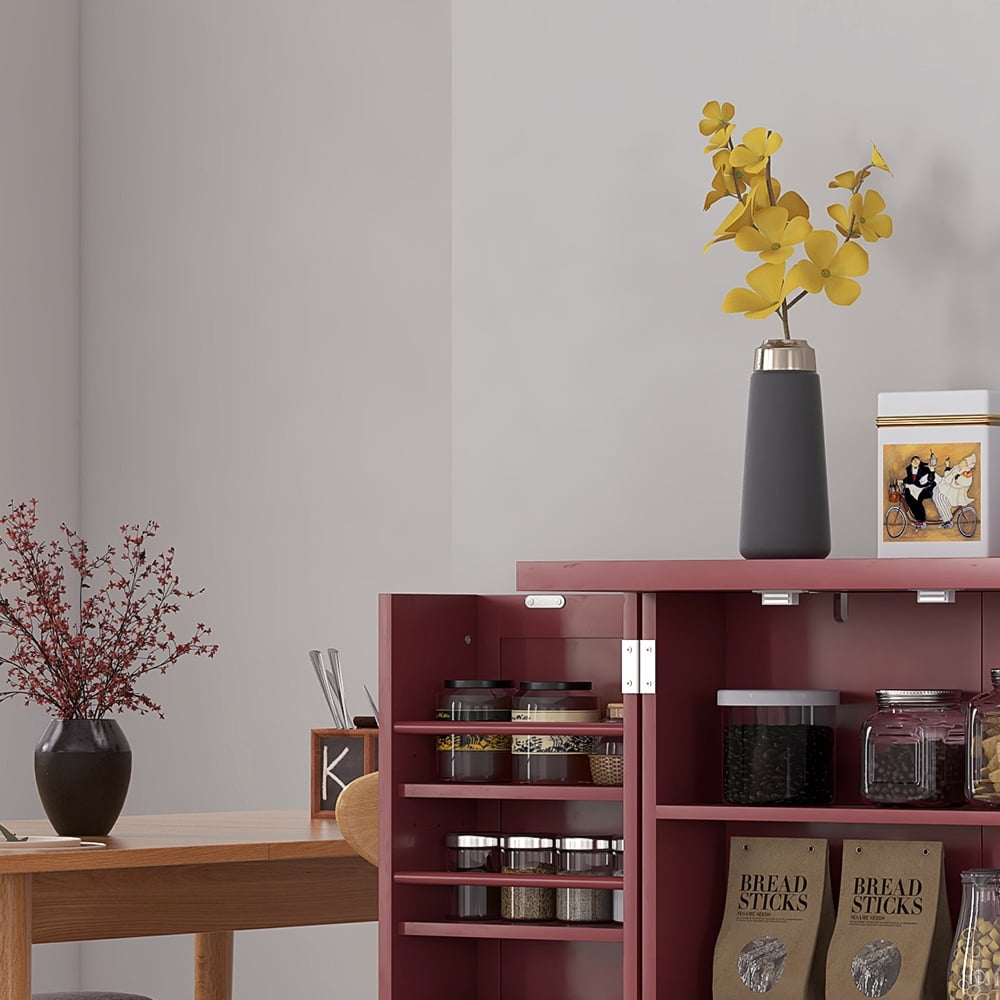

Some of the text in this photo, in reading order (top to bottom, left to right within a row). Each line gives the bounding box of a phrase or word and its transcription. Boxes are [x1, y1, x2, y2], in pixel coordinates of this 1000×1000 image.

[322, 745, 350, 800] K
[739, 874, 808, 893] BREAD
[852, 876, 923, 896] BREAD
[738, 892, 808, 912] STICKS
[851, 895, 923, 915] STICKS
